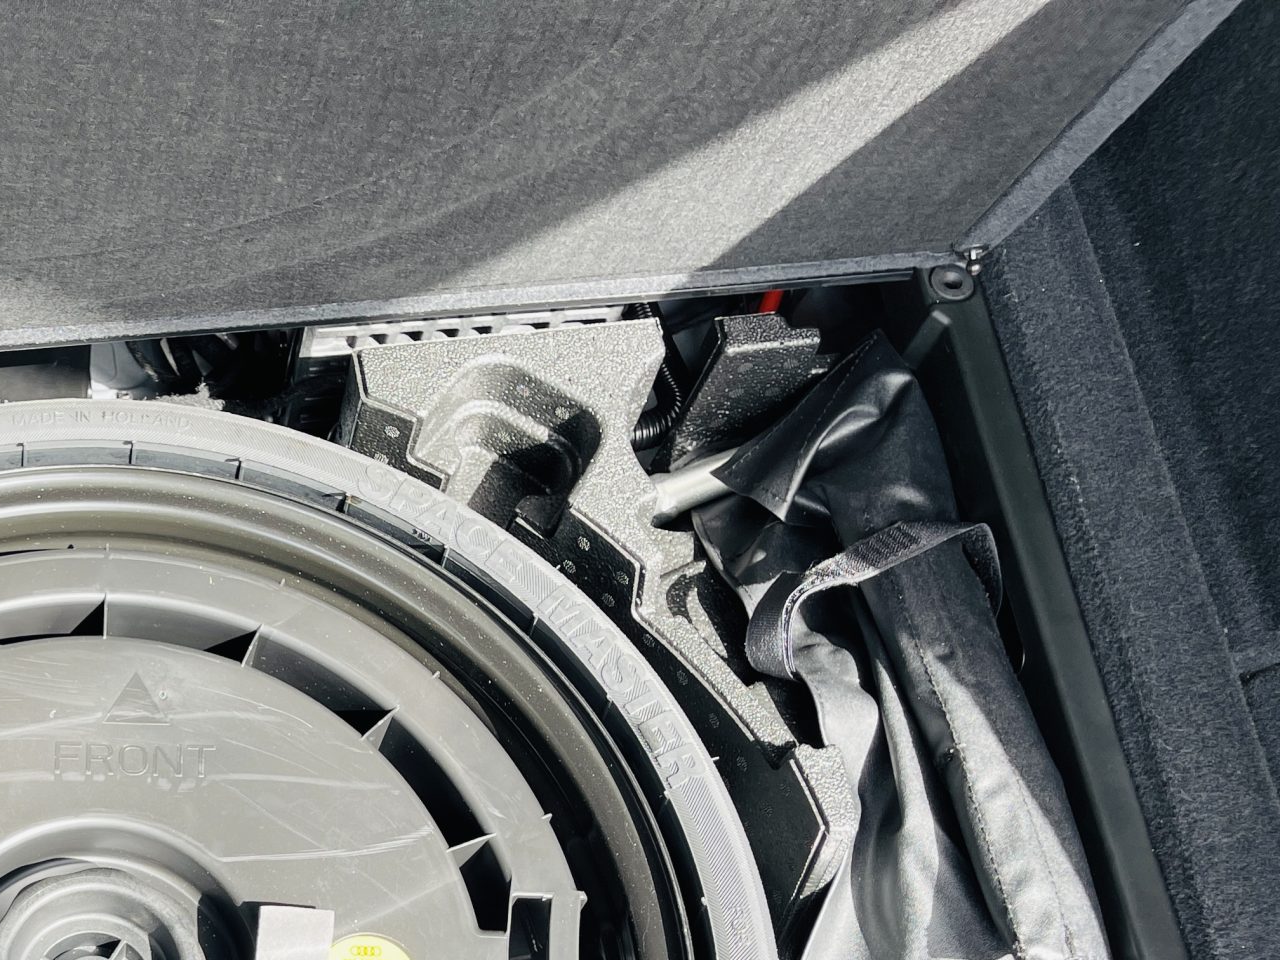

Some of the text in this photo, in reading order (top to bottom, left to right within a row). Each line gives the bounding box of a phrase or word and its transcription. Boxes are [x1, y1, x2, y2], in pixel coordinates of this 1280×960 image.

[12, 408, 66, 427] MADE
[73, 409, 92, 426] IN
[354, 460, 708, 788] SPACE MASTER
[53, 742, 216, 779] FRONT
